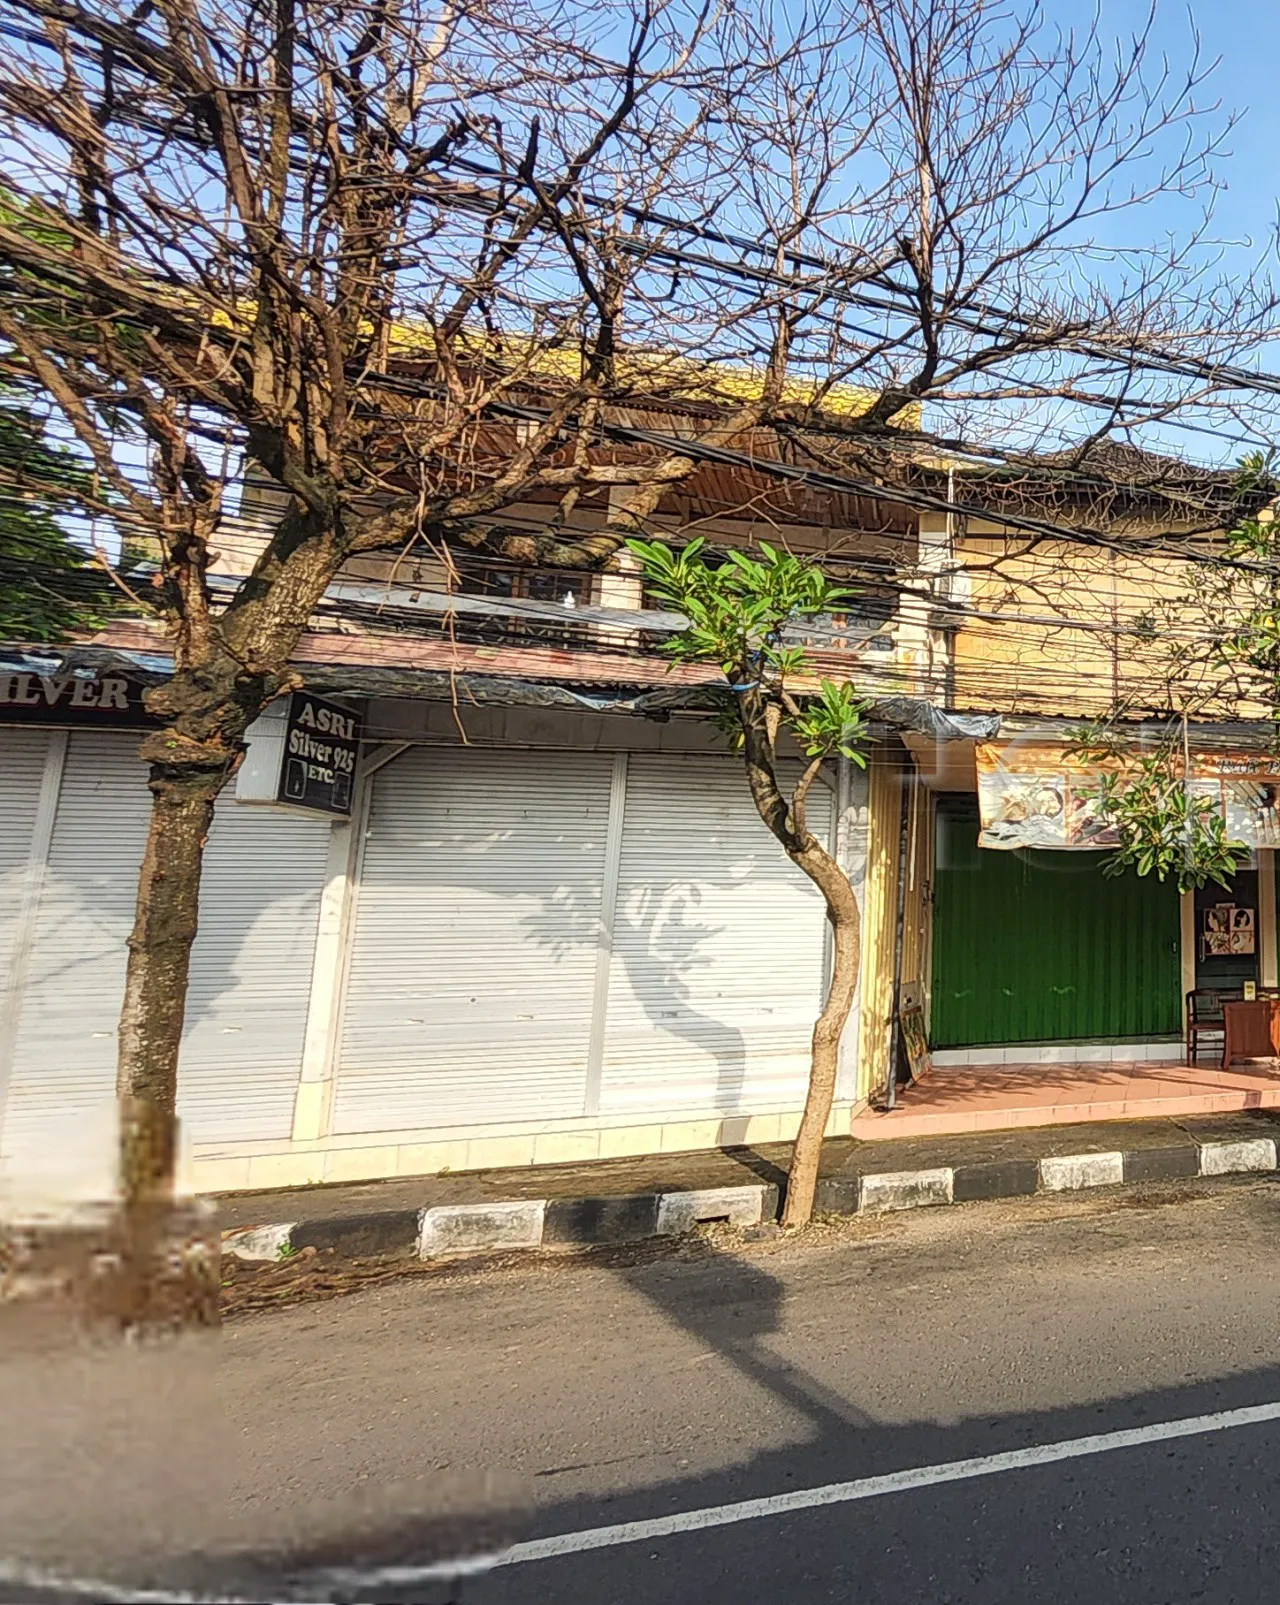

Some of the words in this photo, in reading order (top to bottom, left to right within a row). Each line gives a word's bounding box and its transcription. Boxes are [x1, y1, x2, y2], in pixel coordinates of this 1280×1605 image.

[297, 702, 355, 740] ASRI
[289, 729, 332, 763] Silver
[333, 747, 355, 773] 925
